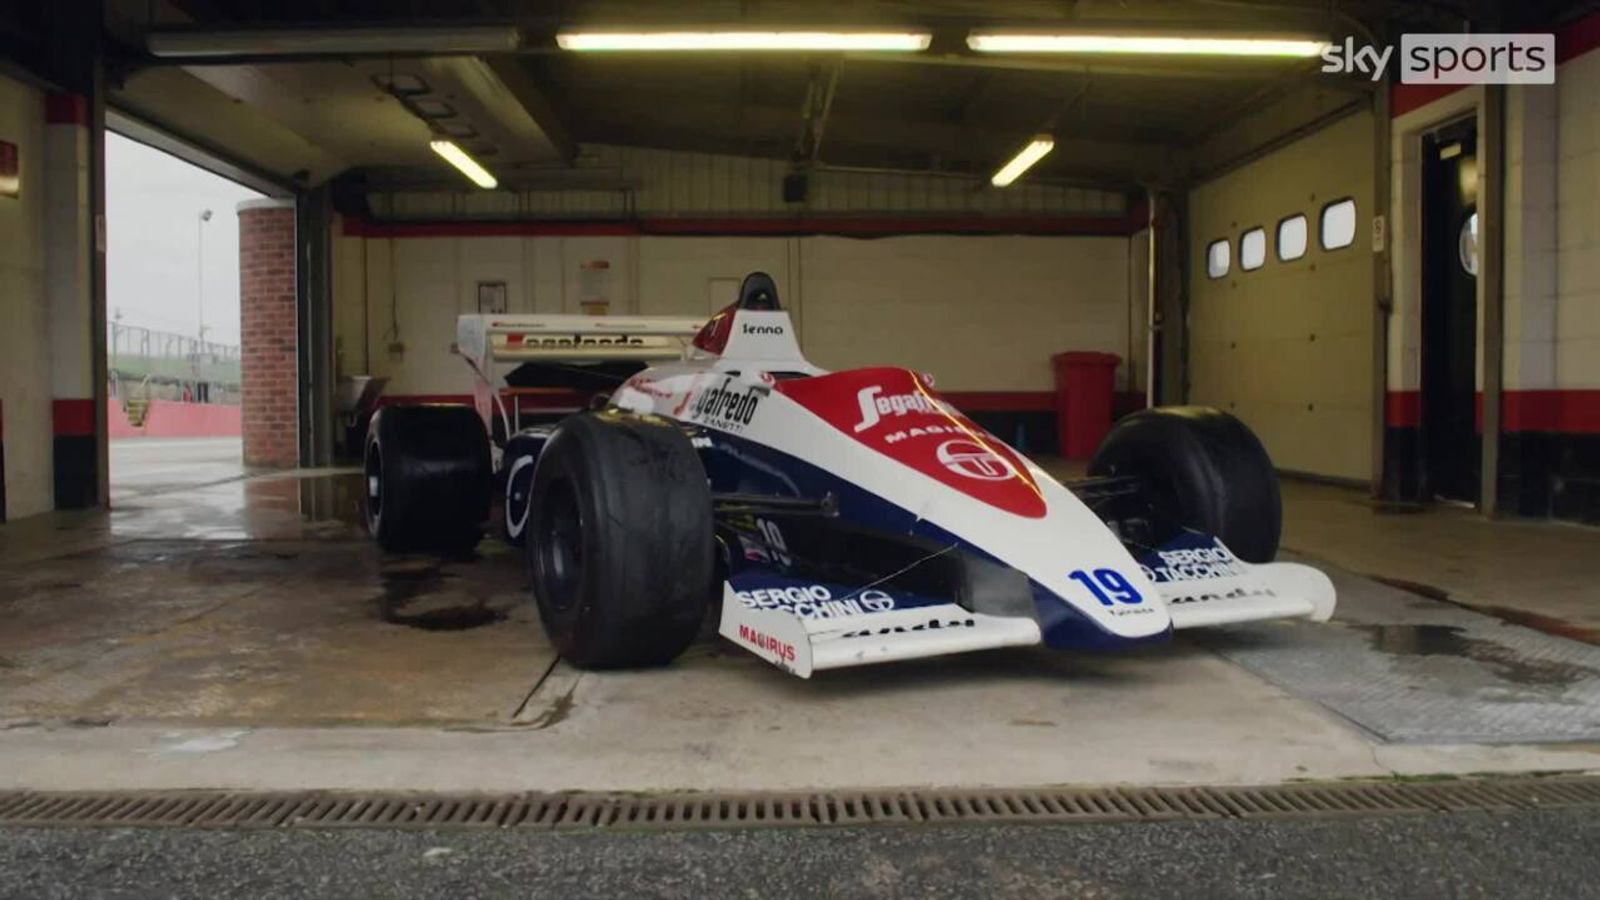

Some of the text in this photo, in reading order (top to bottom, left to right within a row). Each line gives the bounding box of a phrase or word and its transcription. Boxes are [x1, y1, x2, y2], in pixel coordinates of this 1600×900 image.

[756, 518, 791, 566] 19
[1158, 547, 1232, 567] SERGIO
[736, 585, 831, 608] SERGIO
[1068, 568, 1143, 606] 19
[745, 600, 864, 619] CHINI
